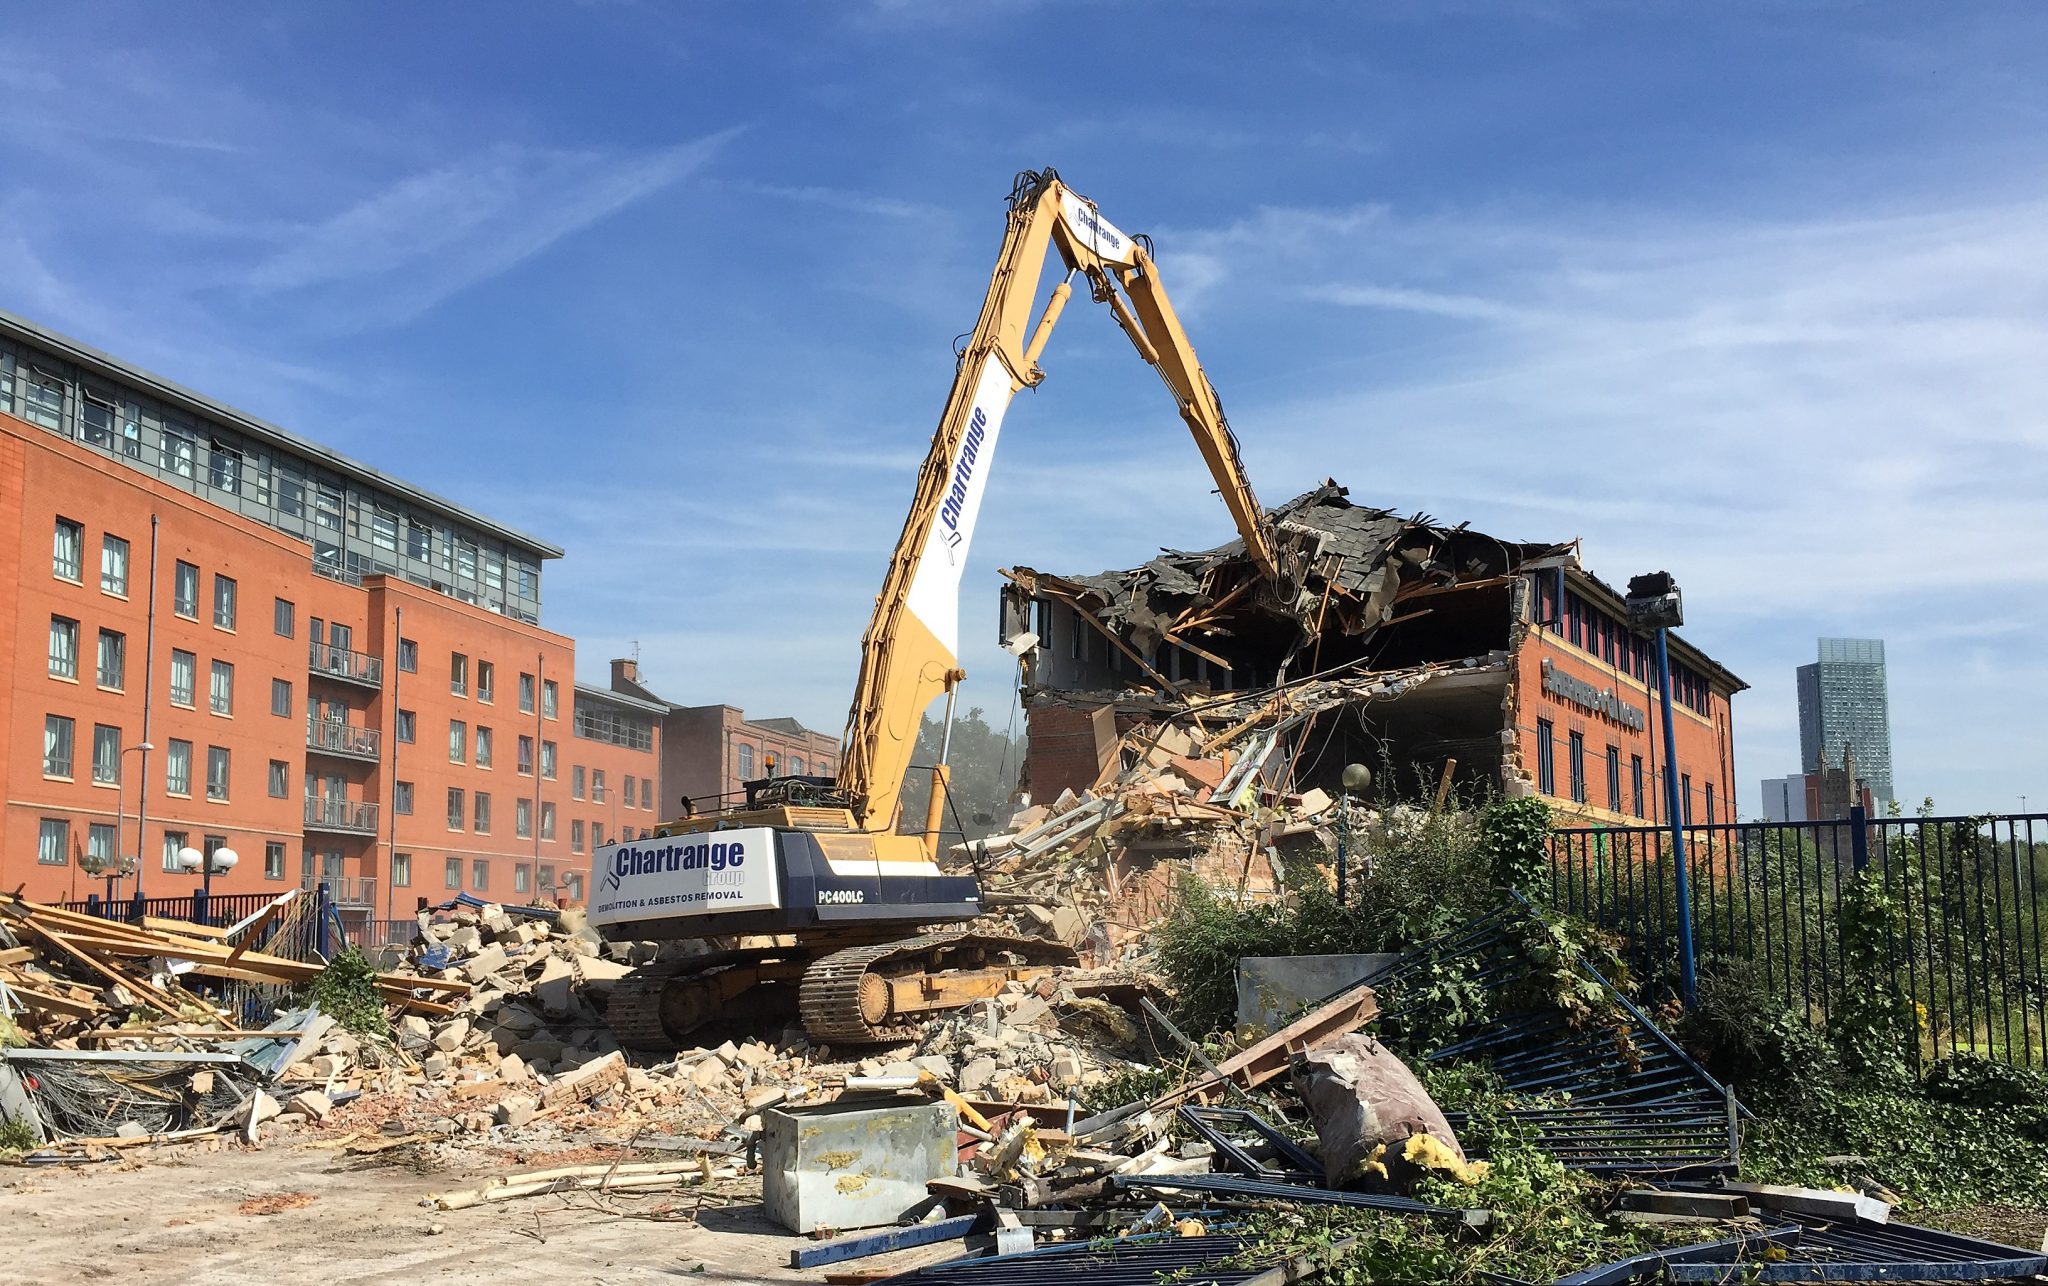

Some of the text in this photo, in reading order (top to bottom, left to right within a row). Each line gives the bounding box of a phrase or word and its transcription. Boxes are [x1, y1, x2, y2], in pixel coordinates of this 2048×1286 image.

[941, 406, 987, 531] Chartrange
[616, 842, 744, 877] Chartrange
[703, 870, 745, 886] Group
[598, 890, 743, 913] DEMOLITION & ASBESTOS REMOVAL
[818, 890, 864, 904] PC400LC
